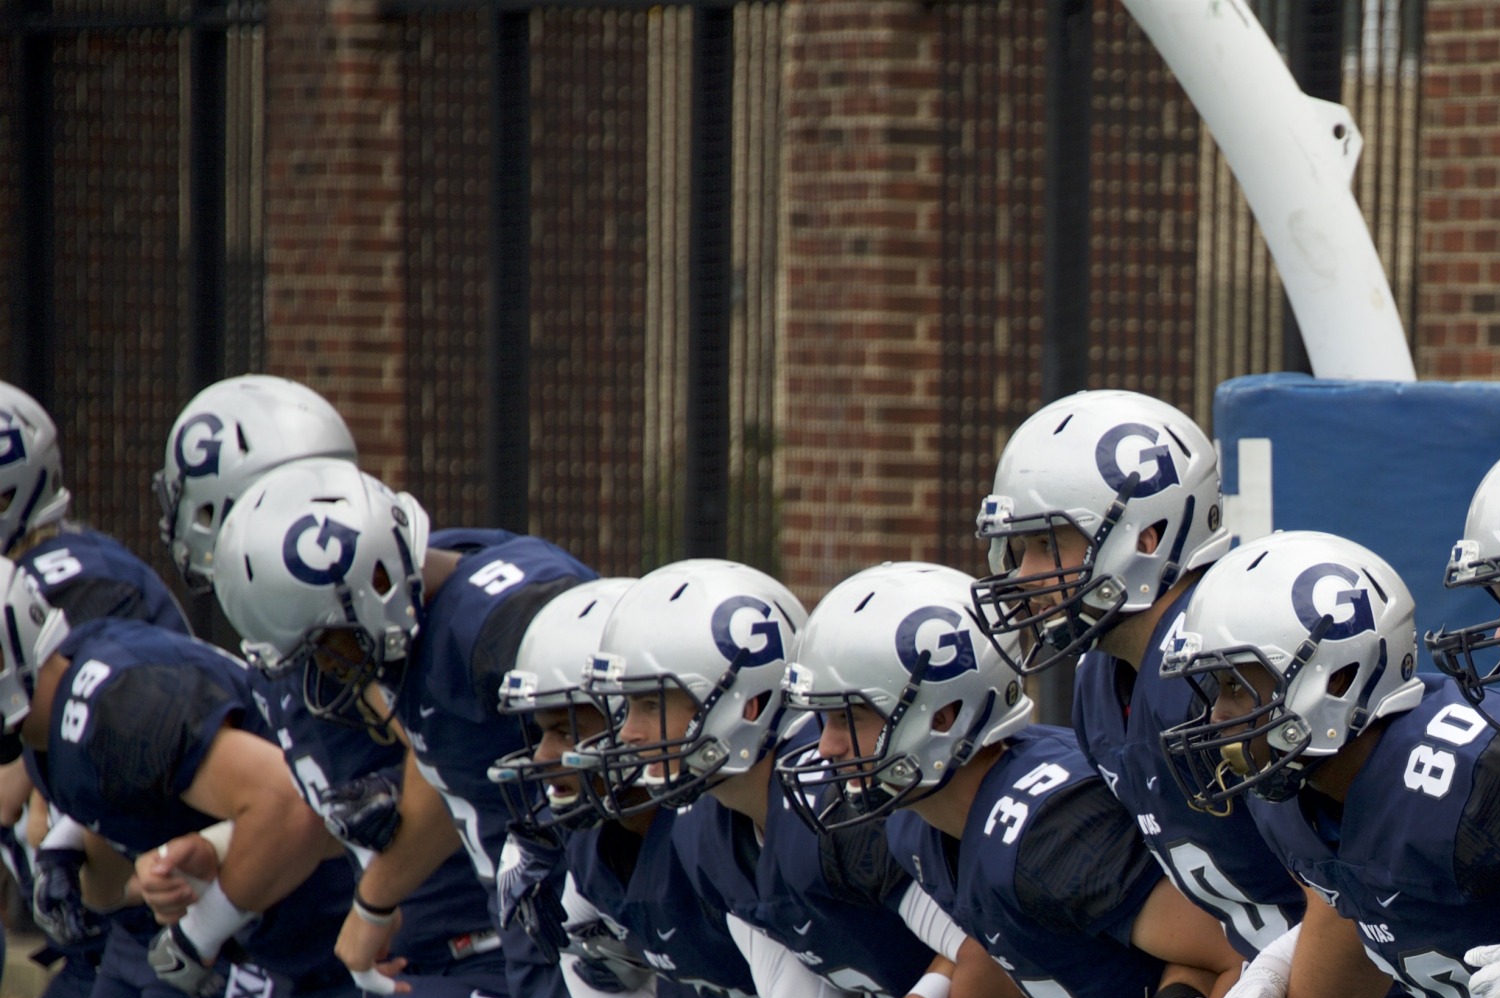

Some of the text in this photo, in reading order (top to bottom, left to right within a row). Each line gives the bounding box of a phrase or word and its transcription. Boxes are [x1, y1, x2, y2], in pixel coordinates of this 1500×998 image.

[175, 413, 224, 478] G
[1095, 422, 1181, 499] G
[282, 514, 361, 587] G
[468, 558, 526, 597] 5
[711, 595, 785, 669] G
[1291, 562, 1377, 641] G
[895, 605, 979, 682] G
[60, 658, 111, 744] 89
[1402, 702, 1489, 800] 80
